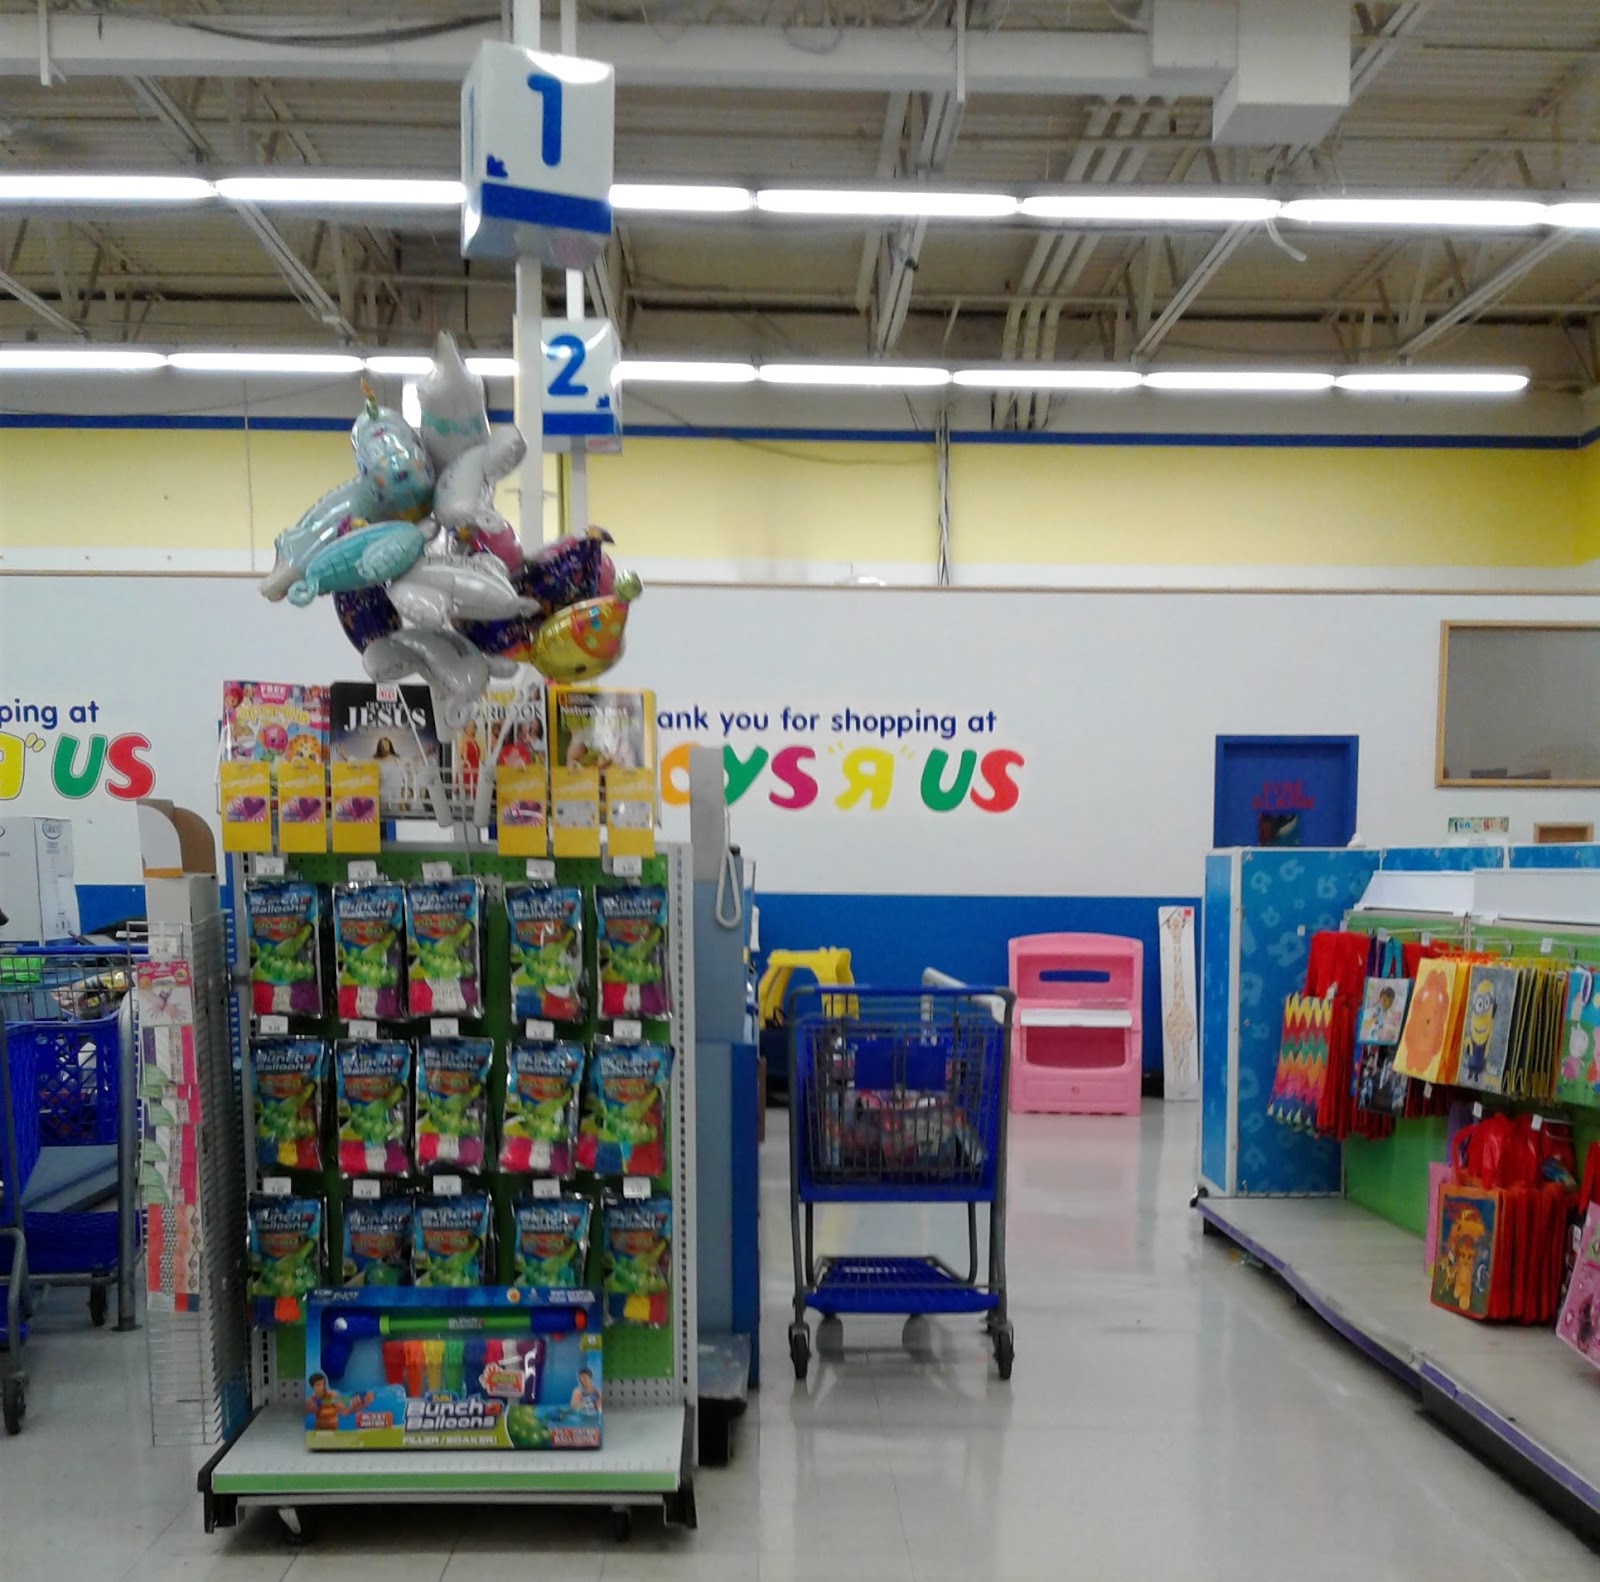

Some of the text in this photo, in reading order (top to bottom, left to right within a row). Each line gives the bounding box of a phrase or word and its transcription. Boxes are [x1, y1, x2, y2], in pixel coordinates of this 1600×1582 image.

[527, 74, 562, 167] 1
[547, 334, 588, 396] 2
[69, 700, 99, 723] at
[344, 706, 427, 732] JESUS
[657, 705, 997, 739] ank you for shopping at
[51, 732, 155, 801] US
[660, 742, 819, 811] OYS
[920, 748, 1025, 813] US
[406, 1415, 496, 1430] Balloons
[407, 1398, 484, 1417] Bunch
